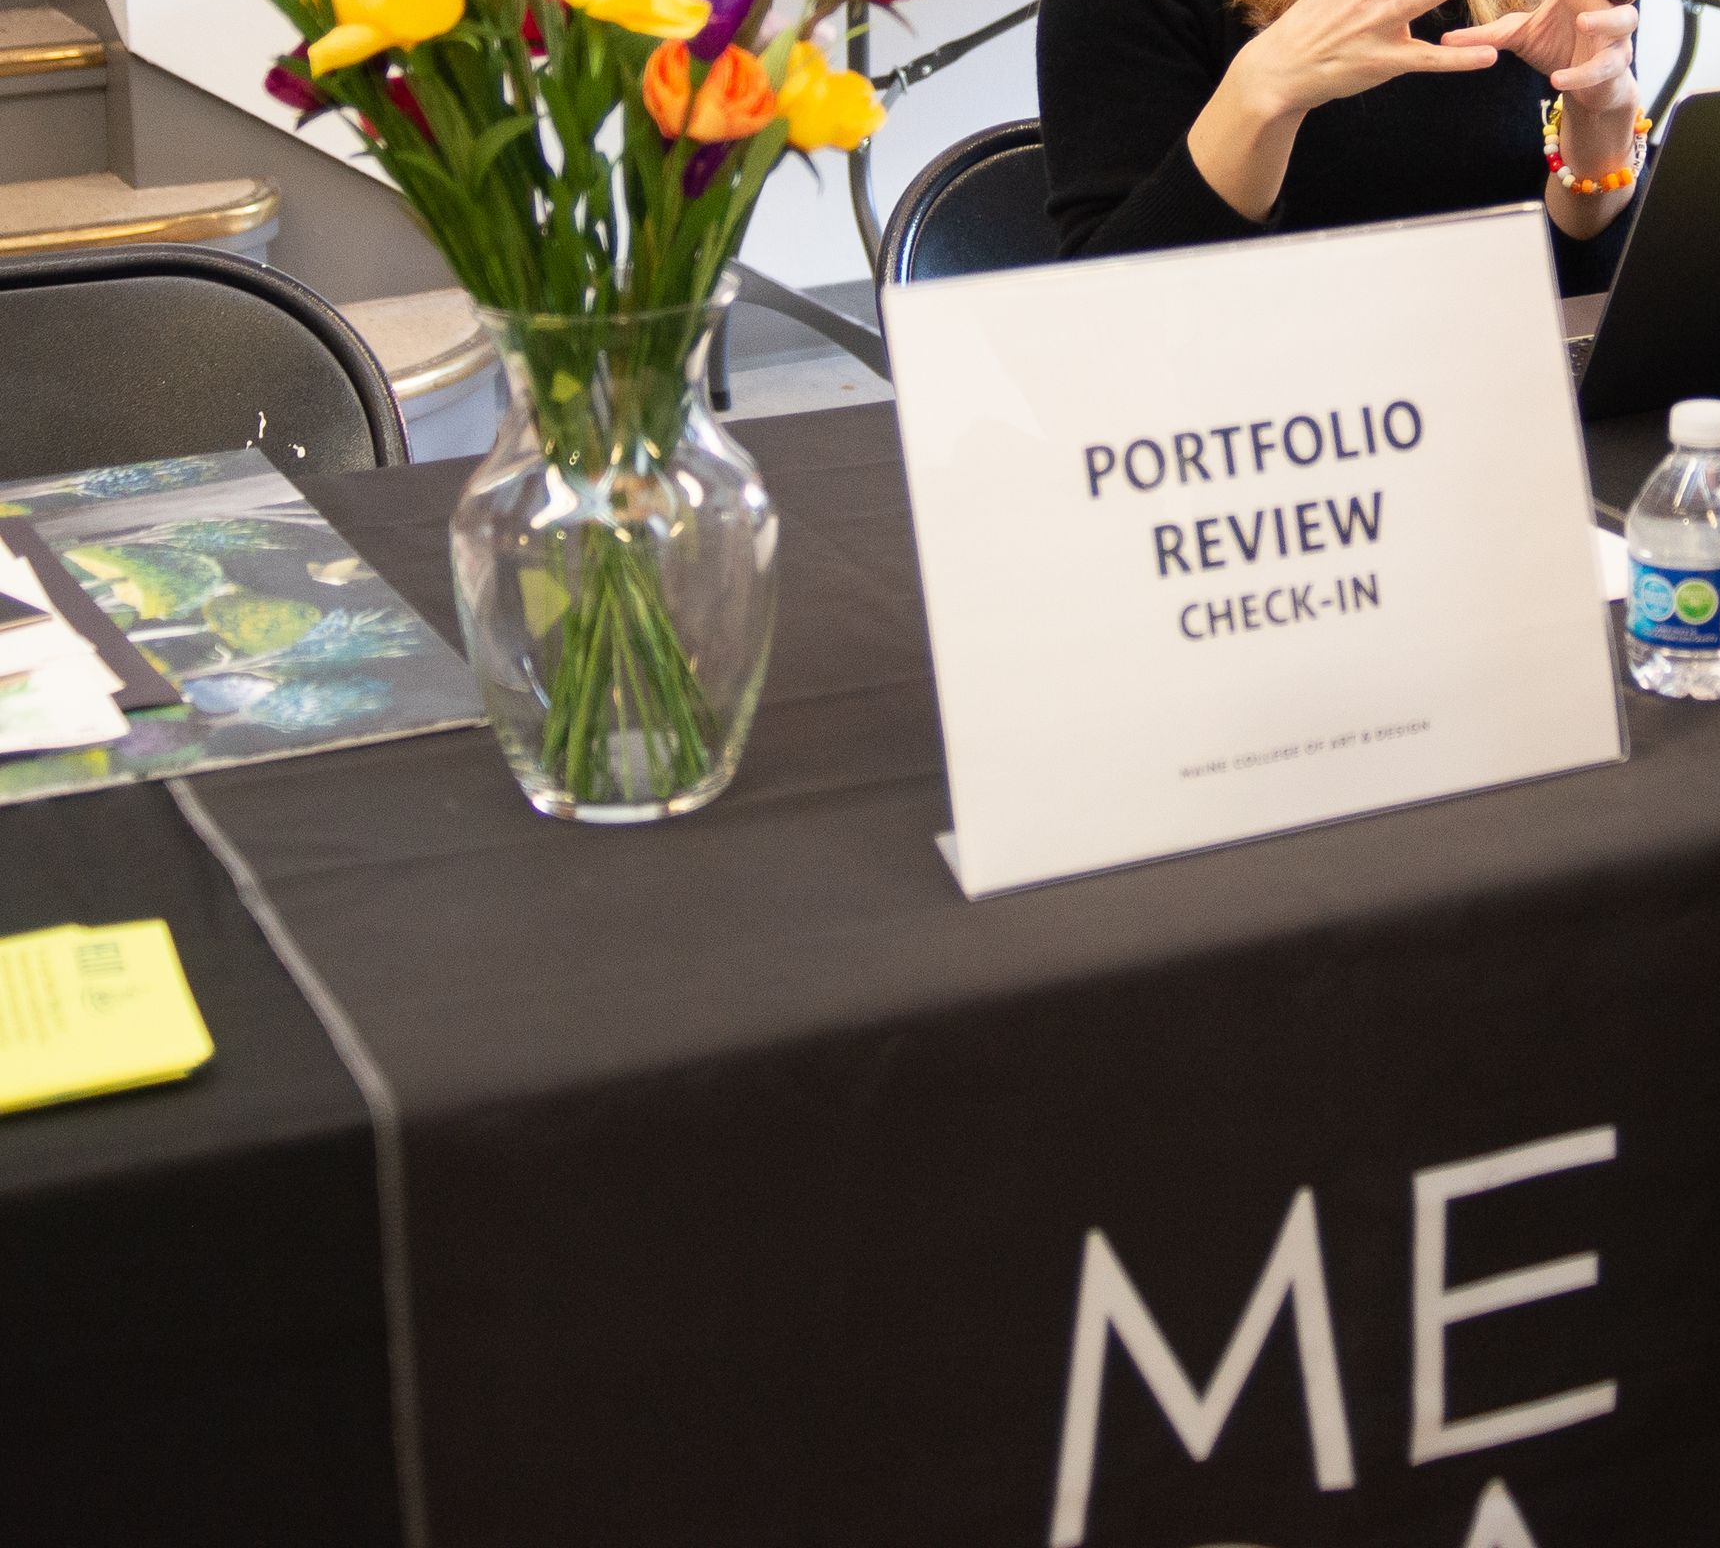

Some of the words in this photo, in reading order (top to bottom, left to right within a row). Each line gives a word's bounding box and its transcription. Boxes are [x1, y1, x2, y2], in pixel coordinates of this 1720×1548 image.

[1082, 399, 1424, 499] PORTFOLIO
[1153, 491, 1384, 578] REVIEW
[1180, 574, 1381, 641] CHECK-IN
[1233, 746, 1299, 769] COLLEGE
[1304, 740, 1324, 754] OF
[1330, 734, 1356, 749] ART
[1375, 720, 1430, 741] DESIGN
[1049, 1123, 1617, 1548] ME
